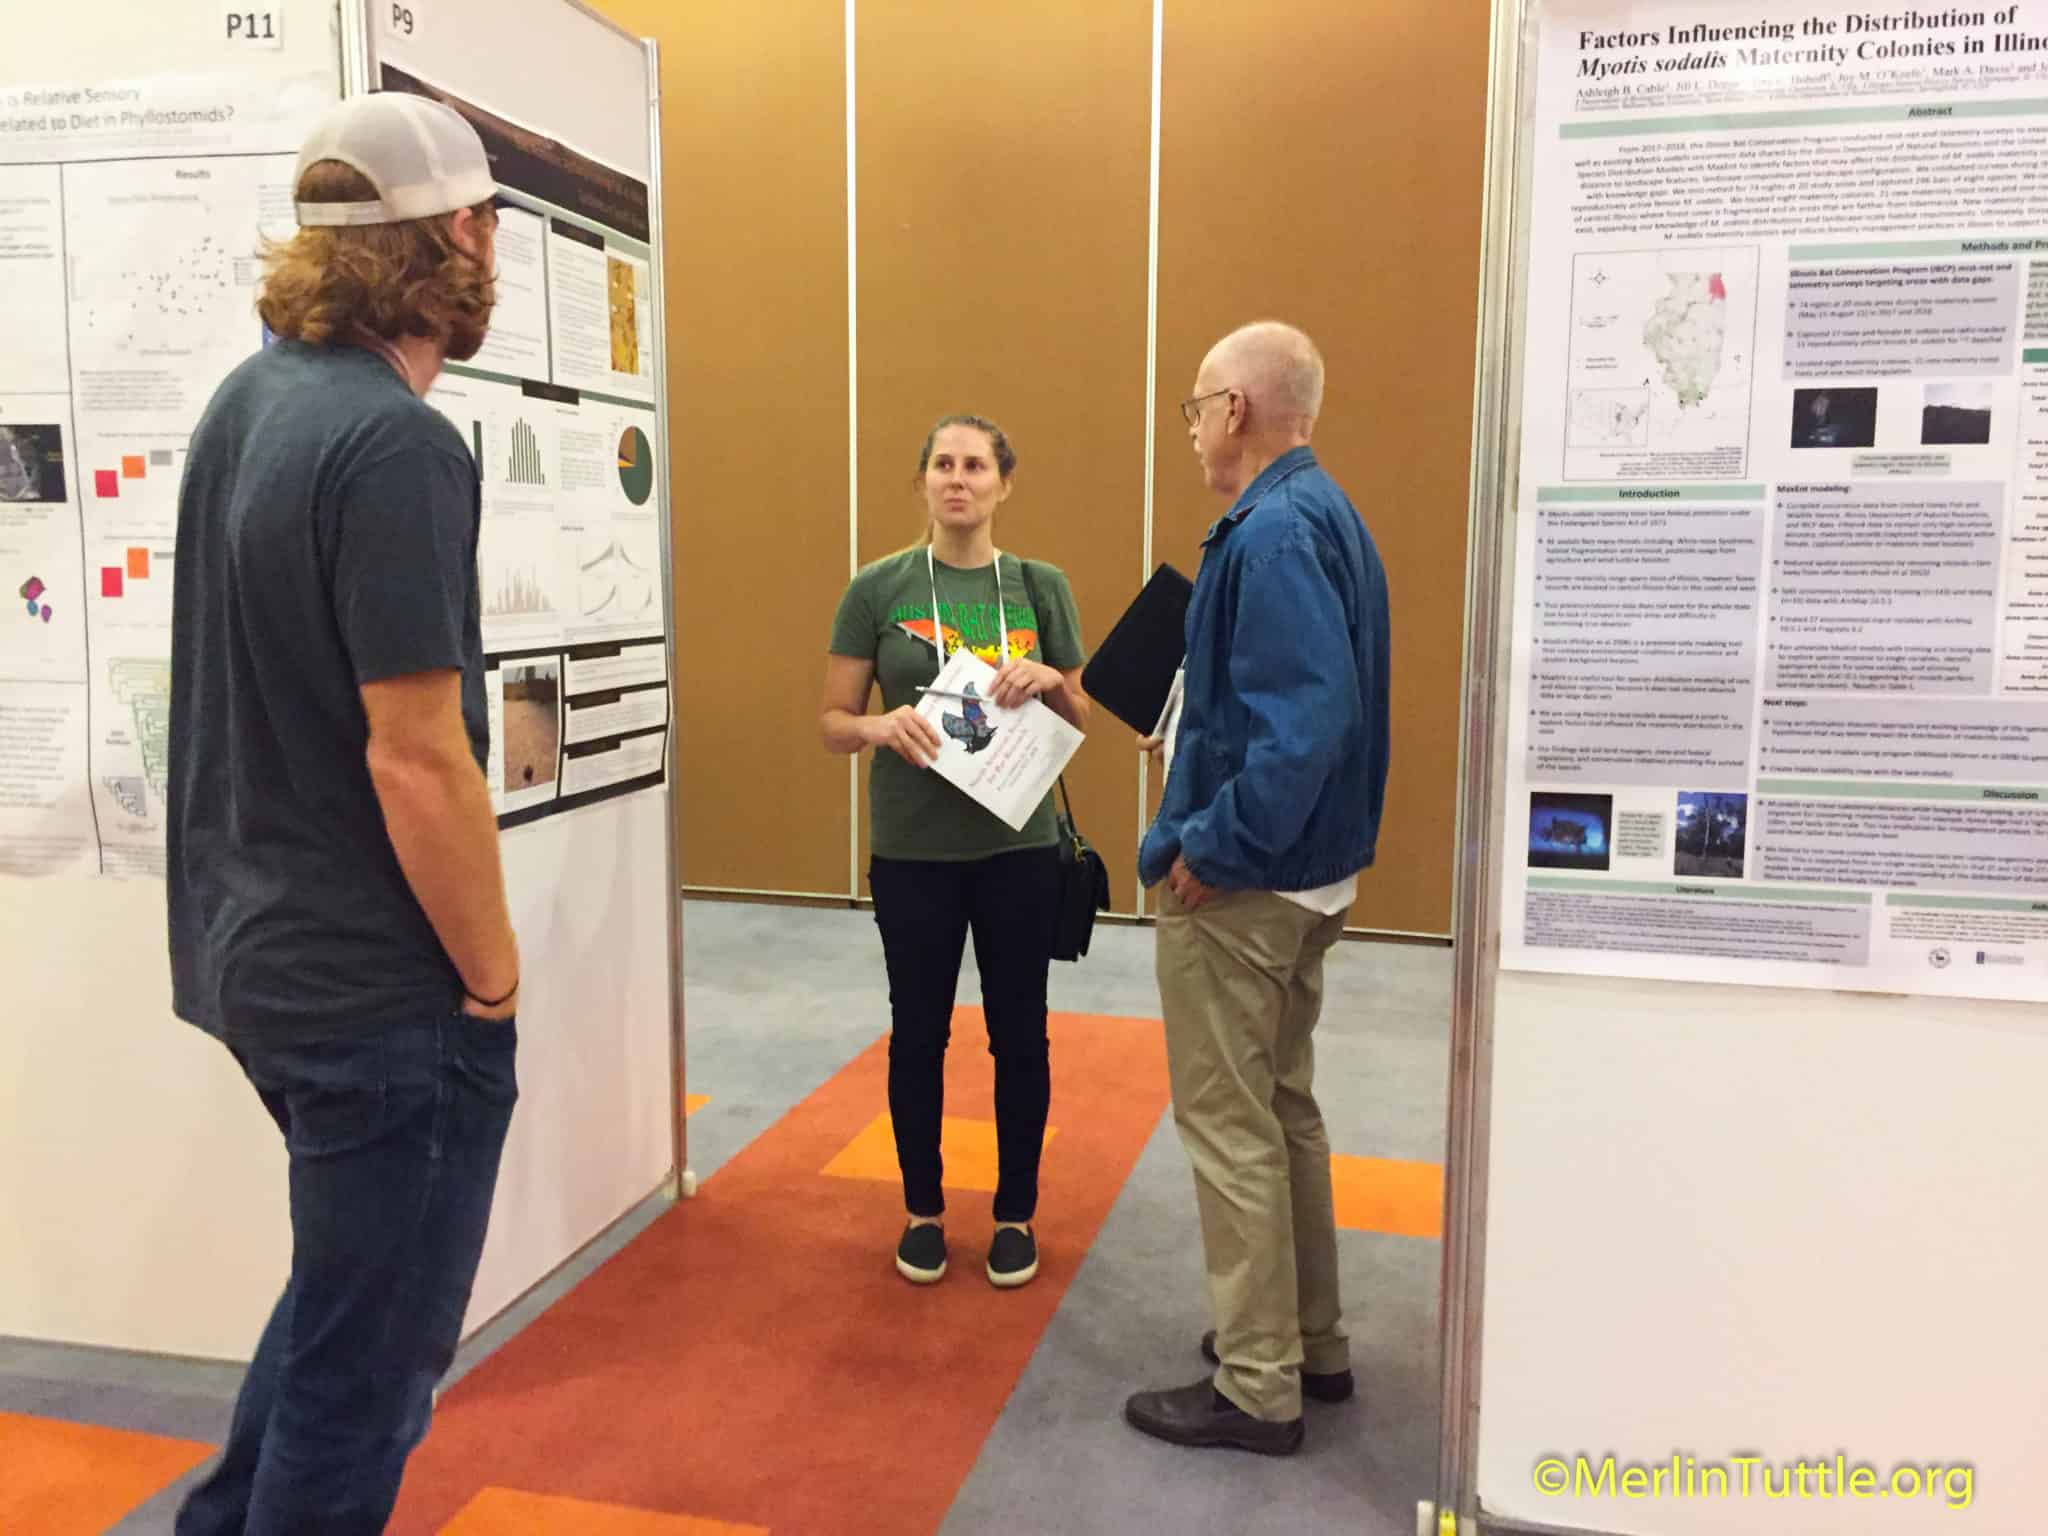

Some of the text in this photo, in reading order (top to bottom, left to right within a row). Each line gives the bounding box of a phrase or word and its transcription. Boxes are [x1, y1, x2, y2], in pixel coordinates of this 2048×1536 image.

[227, 13, 275, 39] P11
[392, 2, 414, 35] P9
[1578, 5, 2018, 50] Factors Influencing the Distribution of
[1576, 55, 1648, 80] Myotis
[1653, 51, 1728, 73] sodalis
[1736, 43, 1848, 67] Maternity
[1857, 37, 1955, 60] Colonies
[1963, 35, 1985, 54] in
[1576, 85, 1619, 99] Ashleigh
[1932, 66, 1959, 78] Mark
[2018, 62, 2036, 73] and
[24, 91, 81, 106] Relative
[84, 87, 141, 105] Sensory
[51, 115, 66, 130] to
[70, 113, 101, 130] Diet
[104, 114, 118, 127] in
[120, 105, 235, 129] Phyllostomids?
[1908, 106, 1953, 118] Abstract
[175, 170, 211, 181] Results
[1961, 242, 2009, 254] Methods
[2012, 240, 2032, 251] and
[1790, 269, 1816, 278] Illinois
[1819, 268, 1832, 277] Bat
[1834, 266, 1889, 276] Conservation
[1892, 265, 1928, 276] Program
[1930, 264, 1956, 275] (IBCP)
[1995, 263, 2012, 272] and
[1789, 280, 1829, 292] telemetry
[1831, 281, 1863, 290] surveys
[1865, 277, 1903, 289] targeting
[1929, 276, 1949, 285] with
[1951, 276, 1970, 284] data
[1618, 488, 1681, 499] Introduction
[1776, 485, 1808, 494] MaxEnt
[1763, 698, 1782, 707] Next
[1983, 789, 2039, 800] Discussion
[1676, 885, 1715, 895] Literature
